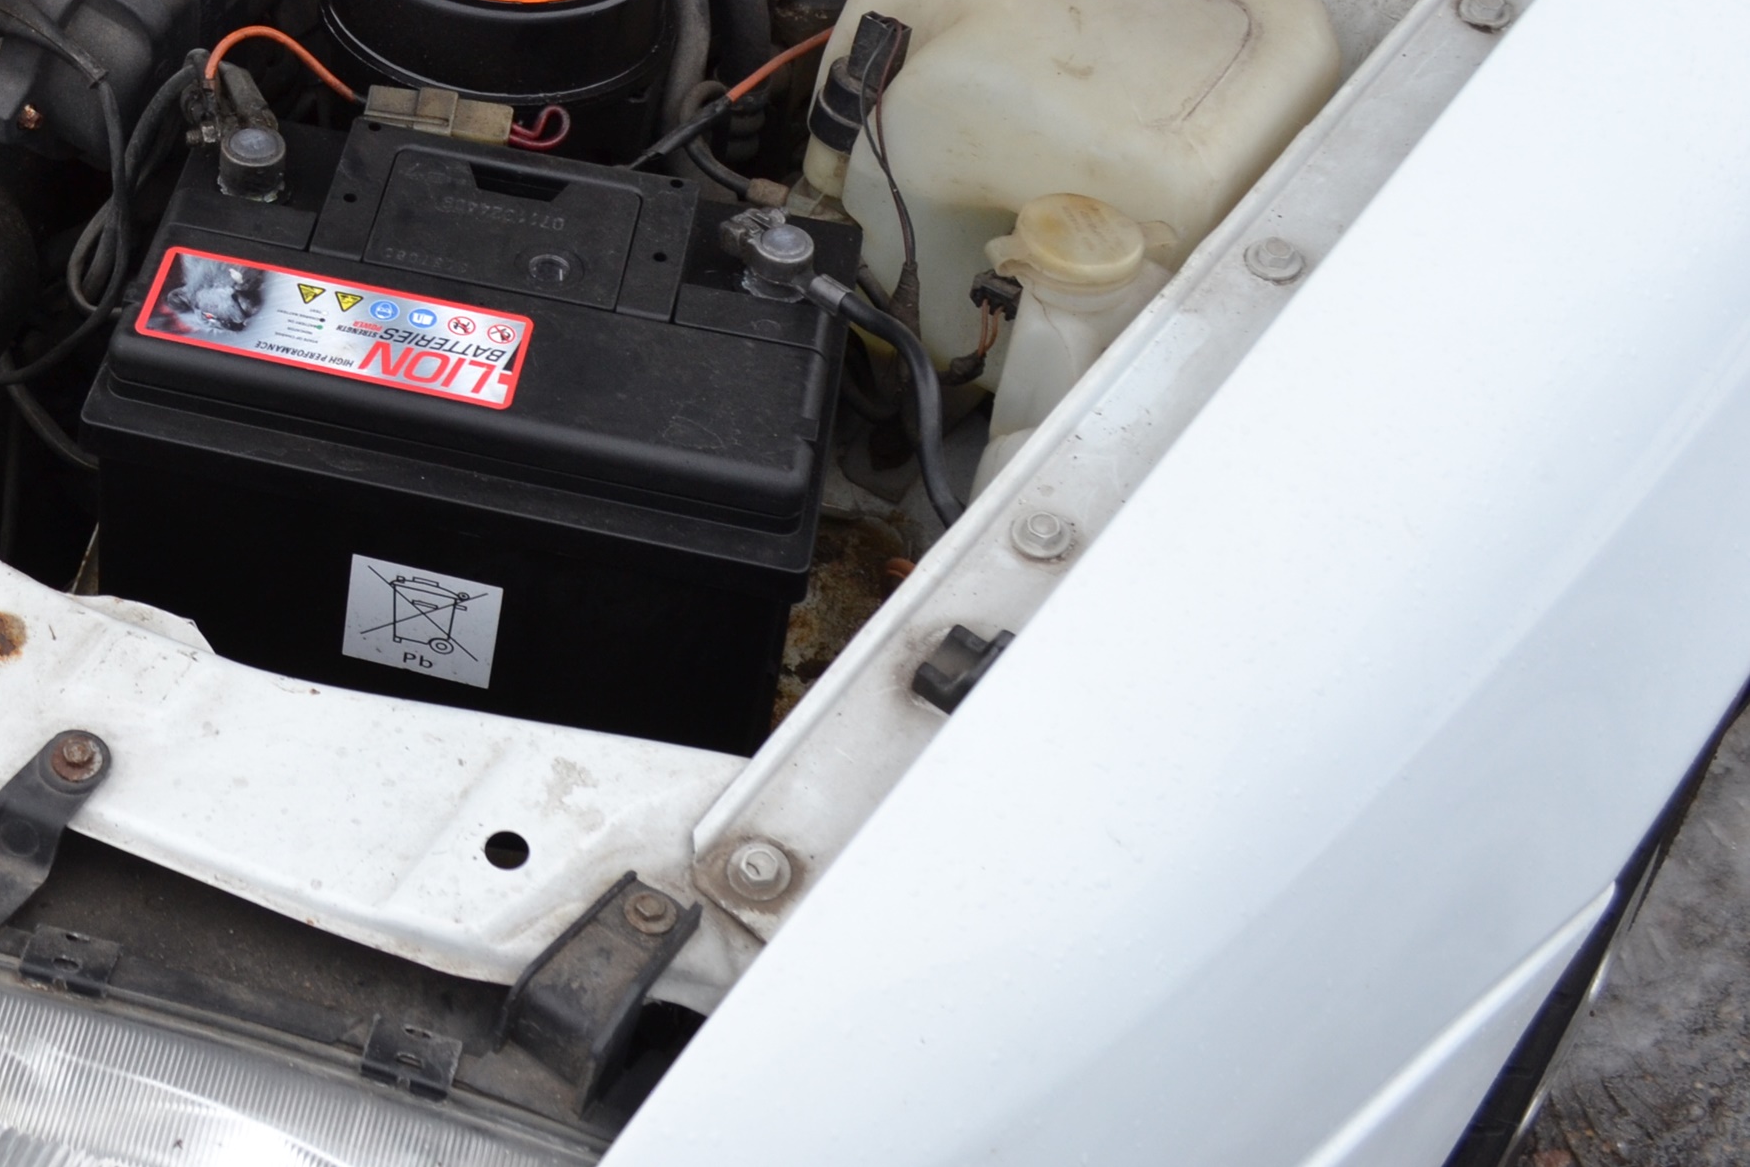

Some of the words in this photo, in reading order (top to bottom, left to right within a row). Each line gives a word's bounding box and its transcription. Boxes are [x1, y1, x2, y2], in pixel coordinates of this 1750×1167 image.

[334, 322, 379, 339] STRENGTH
[253, 338, 327, 362] PERFORMANCE
[378, 325, 506, 364] BATTERIES
[326, 354, 354, 368] HIGH
[358, 340, 498, 395] LION
[402, 652, 434, 669] Pb
